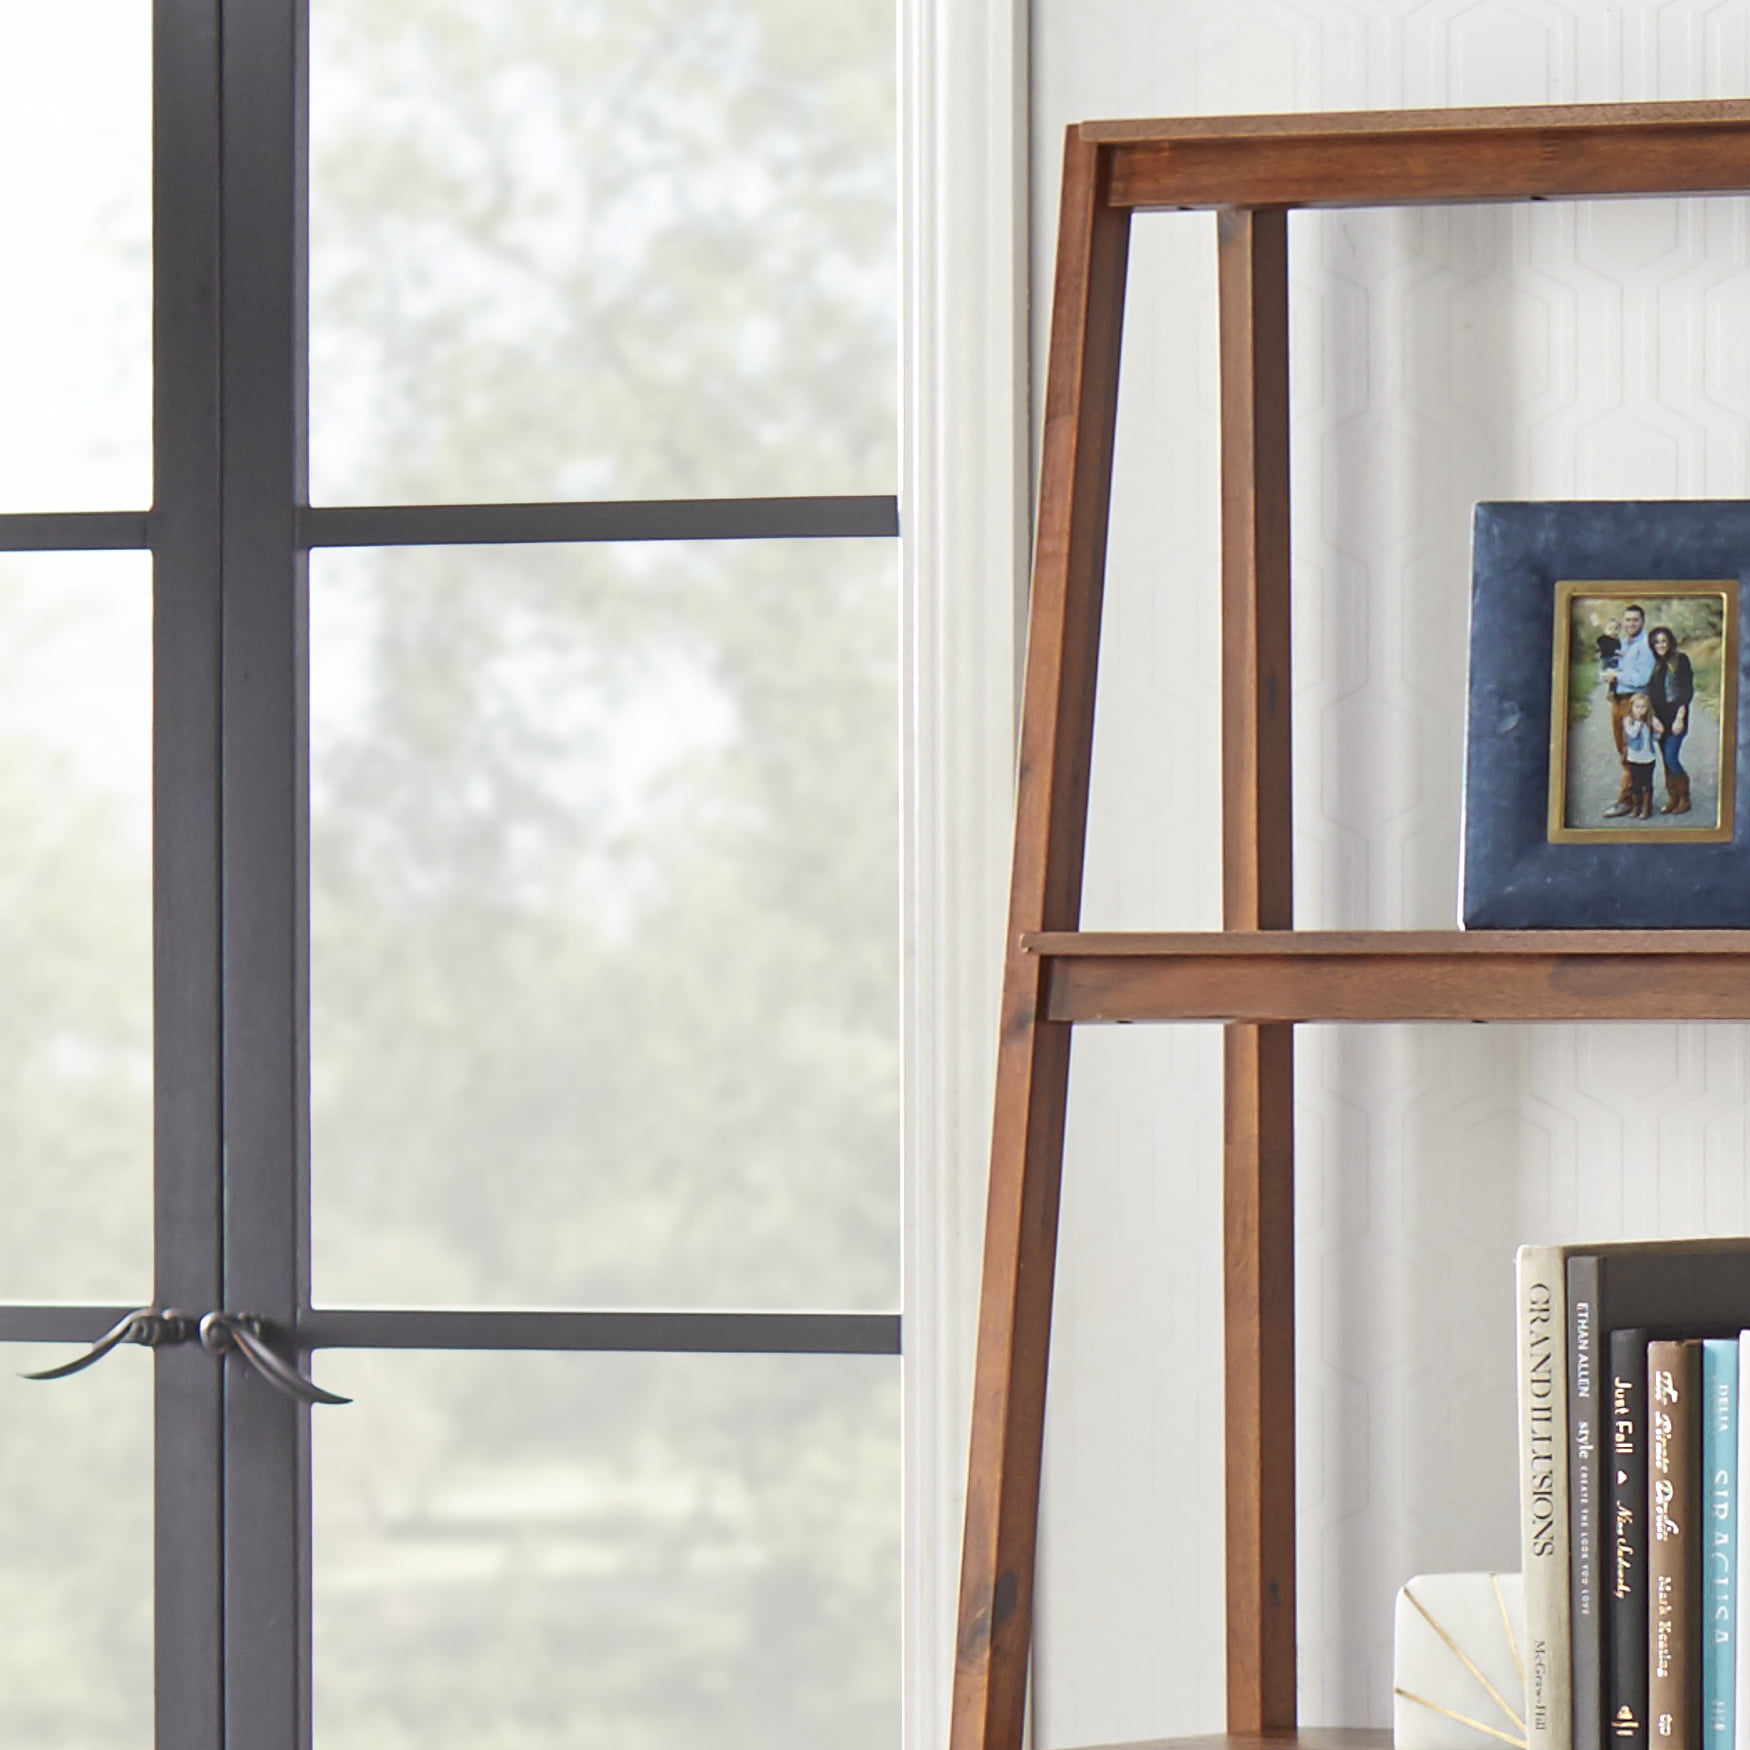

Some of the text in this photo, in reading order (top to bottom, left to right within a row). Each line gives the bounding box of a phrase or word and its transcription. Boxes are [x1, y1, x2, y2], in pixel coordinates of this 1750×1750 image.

[1576, 1302, 1590, 1398] ETHAN ALLEN
[1529, 1282, 1555, 1557] GRAND ILLUSIONS
[1576, 1421, 1595, 1459] style
[1614, 1376, 1634, 1454] Just Fall
[1718, 1384, 1729, 1433] DELIA
[1711, 1469, 1729, 1646] SIRACUSA
